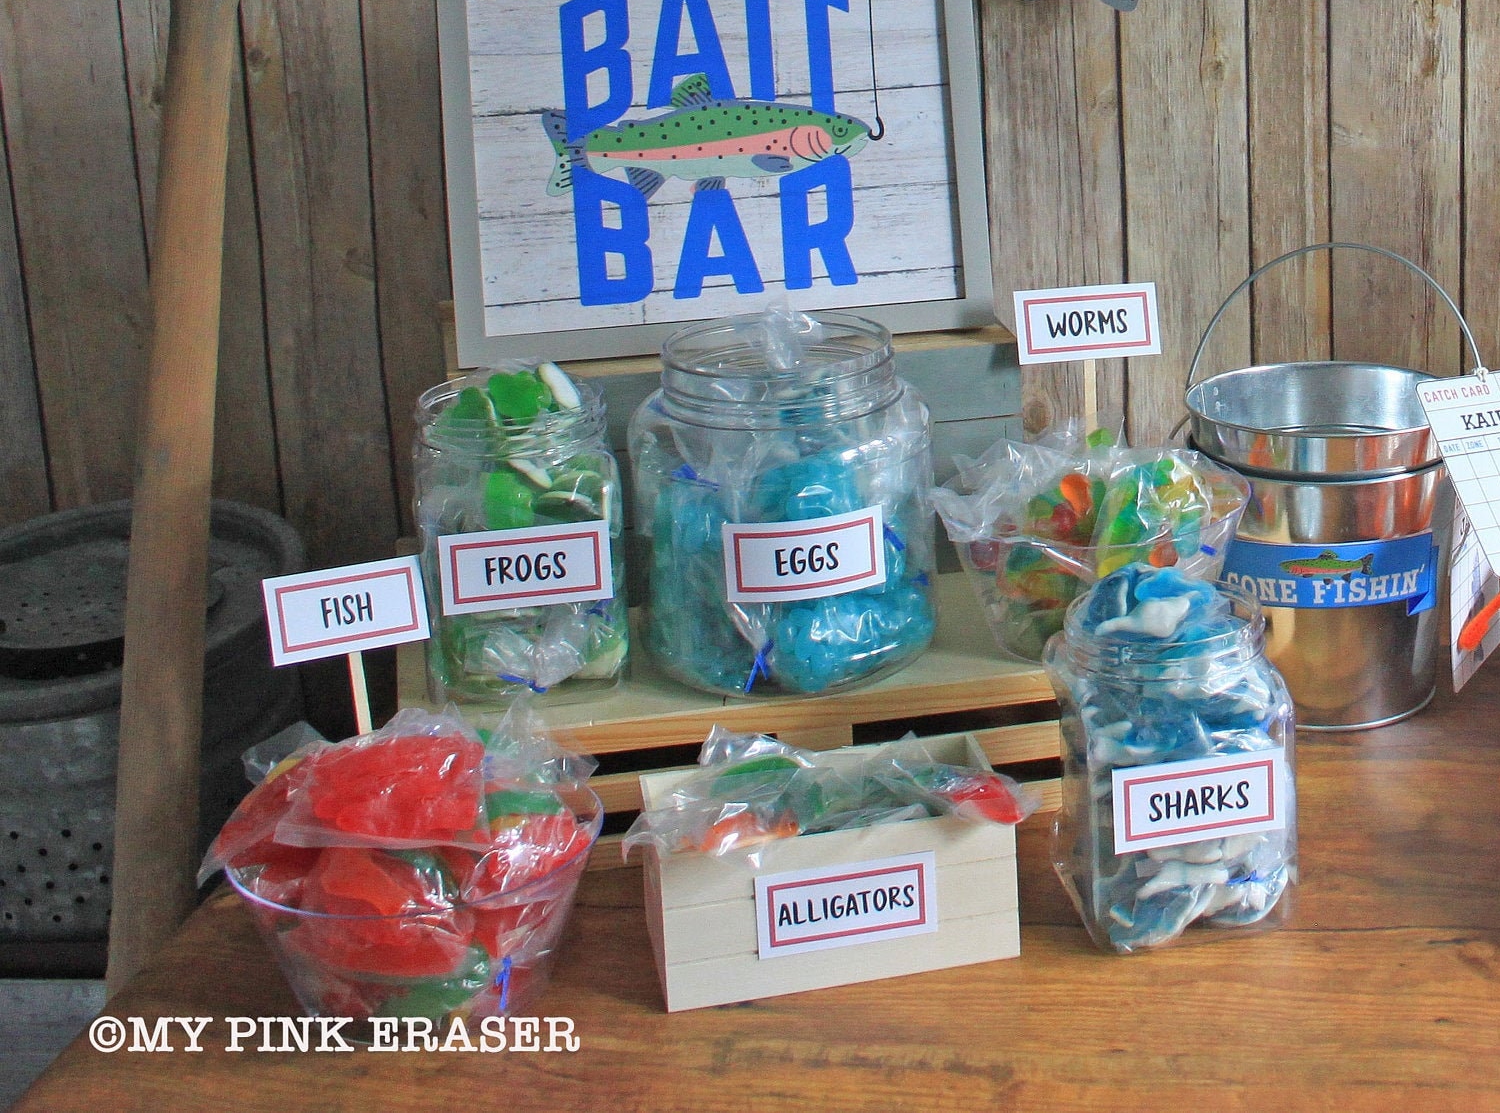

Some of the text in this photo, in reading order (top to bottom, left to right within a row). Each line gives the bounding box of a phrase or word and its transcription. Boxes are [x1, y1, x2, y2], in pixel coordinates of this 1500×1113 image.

[571, 154, 859, 307] BAR
[1046, 308, 1128, 338] WORMS
[1424, 384, 1490, 403] CATCH CARD
[1443, 443, 1460, 453] DATE
[484, 550, 568, 586] FROGS
[773, 540, 840, 576] EGGS
[1312, 563, 1425, 604] FISHIN'
[320, 591, 374, 629] FISH
[1149, 780, 1251, 823] SHARKS
[778, 884, 915, 928] ALLIGATORS
